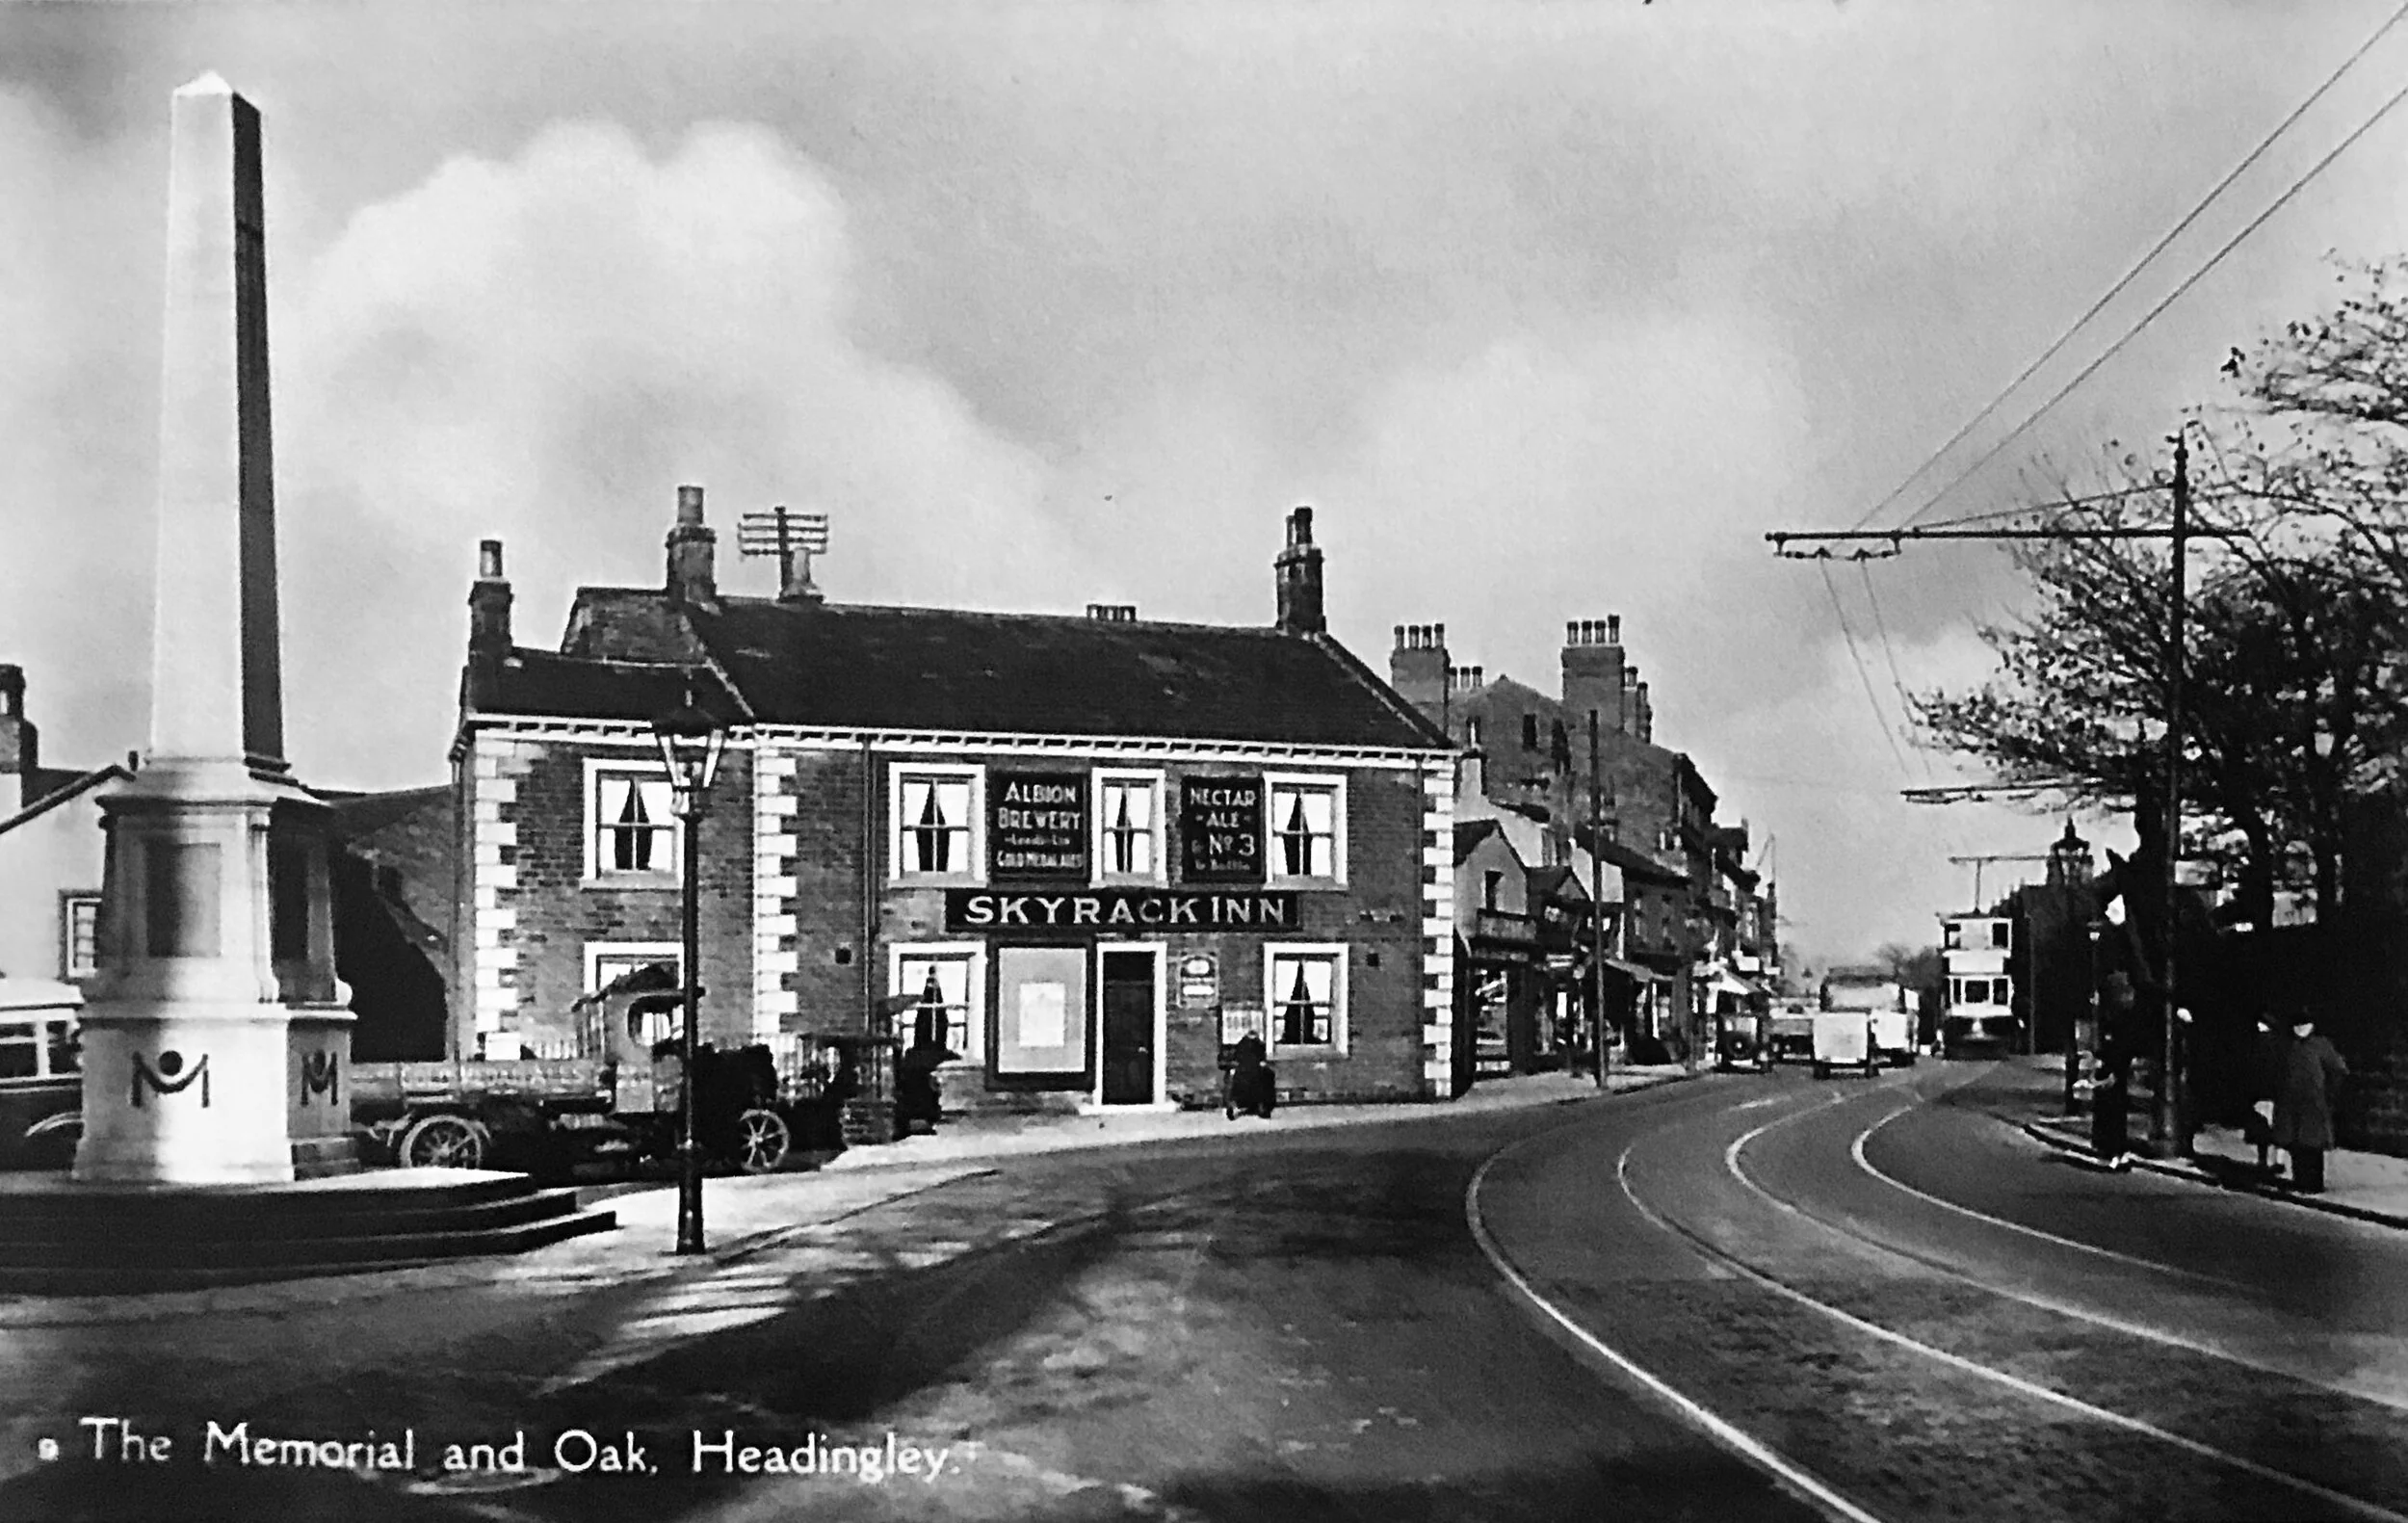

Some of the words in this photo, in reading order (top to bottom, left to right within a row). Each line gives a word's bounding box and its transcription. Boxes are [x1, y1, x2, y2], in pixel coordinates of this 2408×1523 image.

[1005, 781, 1076, 803] ALBION
[1191, 788, 1256, 806] NECTAR
[998, 806, 1081, 829] BREWERY
[1206, 811, 1240, 827] ALE
[1239, 833, 1255, 856] 3
[964, 895, 1200, 925] SKYRACK
[1211, 895, 1285, 926] INN
